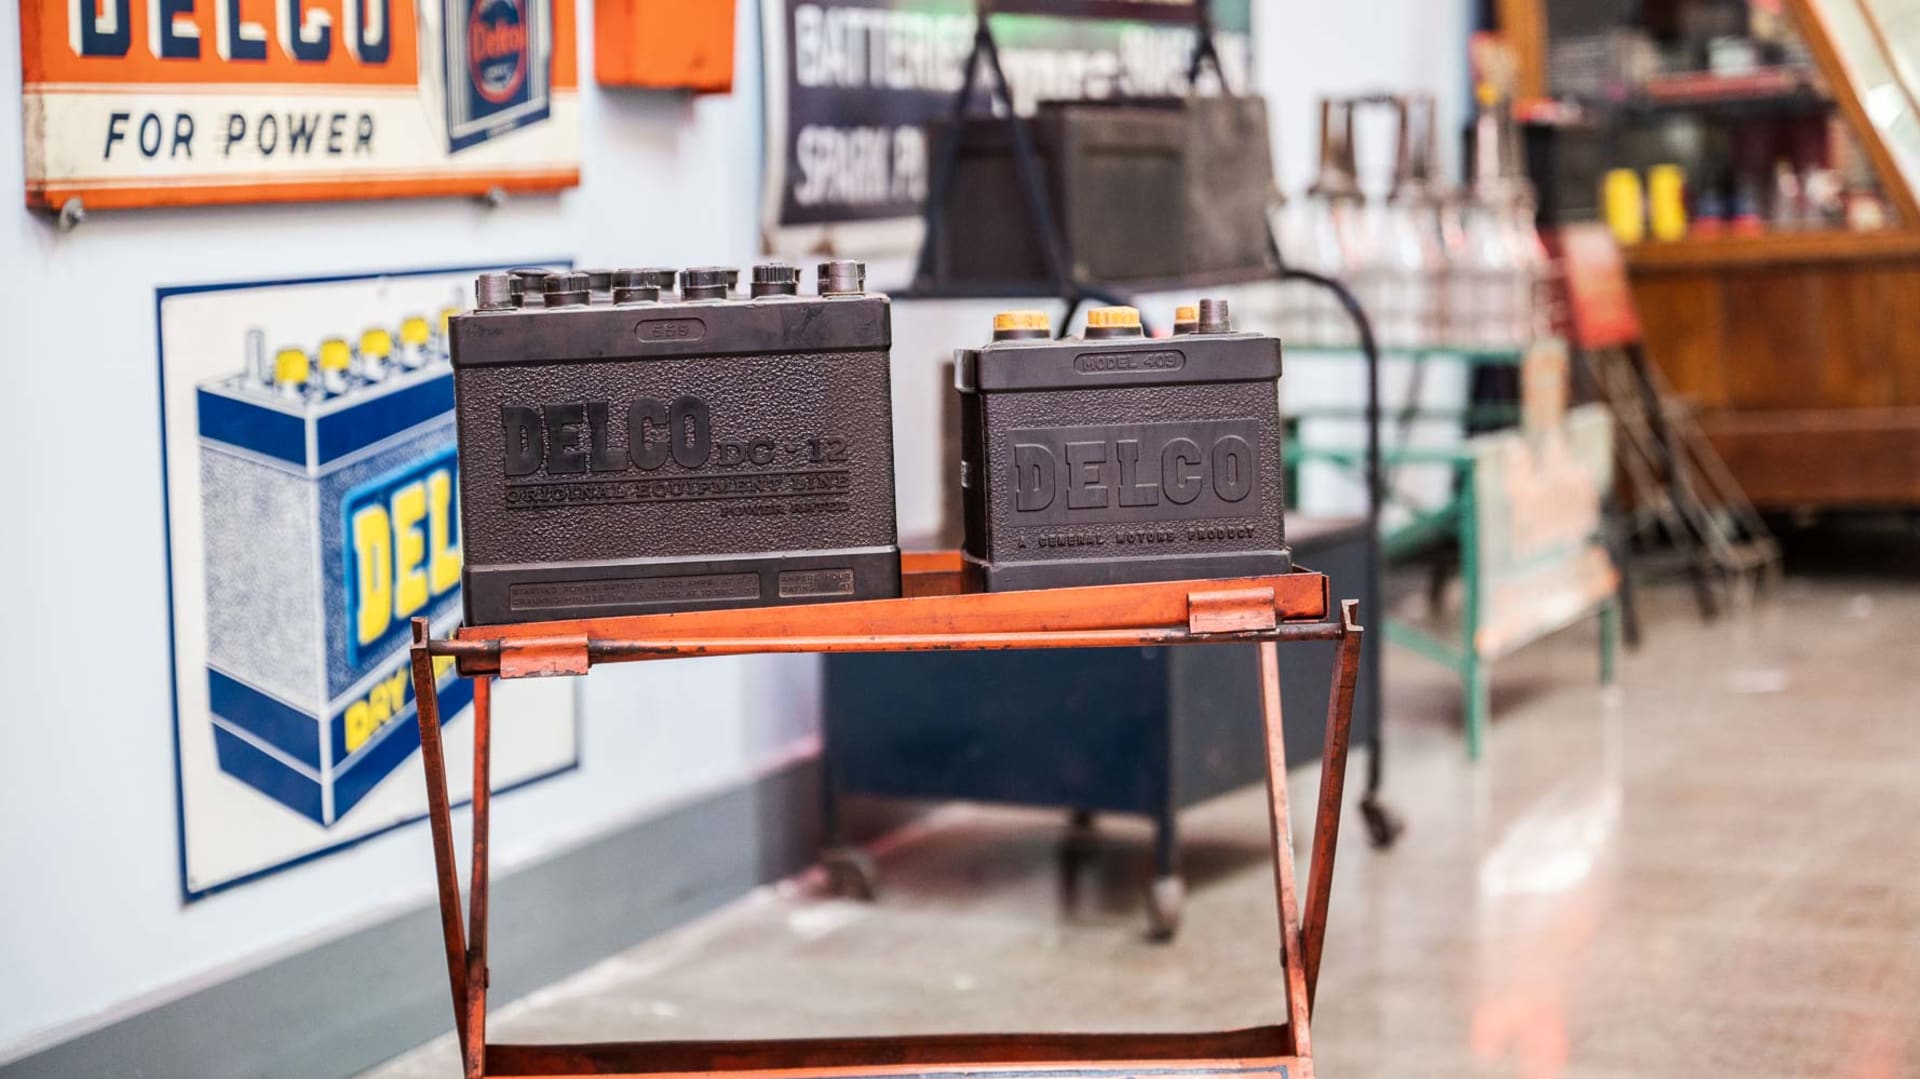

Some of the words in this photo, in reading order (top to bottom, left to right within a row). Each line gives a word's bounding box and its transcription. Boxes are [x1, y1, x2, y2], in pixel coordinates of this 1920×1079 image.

[103, 112, 195, 159] FOR
[223, 112, 376, 156] POWER
[1081, 355, 1138, 372] MODEL
[503, 394, 712, 476] DELCO
[505, 481, 626, 502] ORIGINAL
[635, 476, 784, 498] EQUIPMENT
[789, 473, 850, 490] LINE
[1014, 434, 1253, 513] DELCO
[719, 502, 787, 517] POWER
[353, 468, 461, 647] DEL
[1018, 536, 1026, 549] A
[1038, 532, 1104, 548] GENERAL
[1115, 529, 1176, 545] MOTORS
[1187, 525, 1256, 542] PRODUCT
[343, 665, 409, 755] DRY
